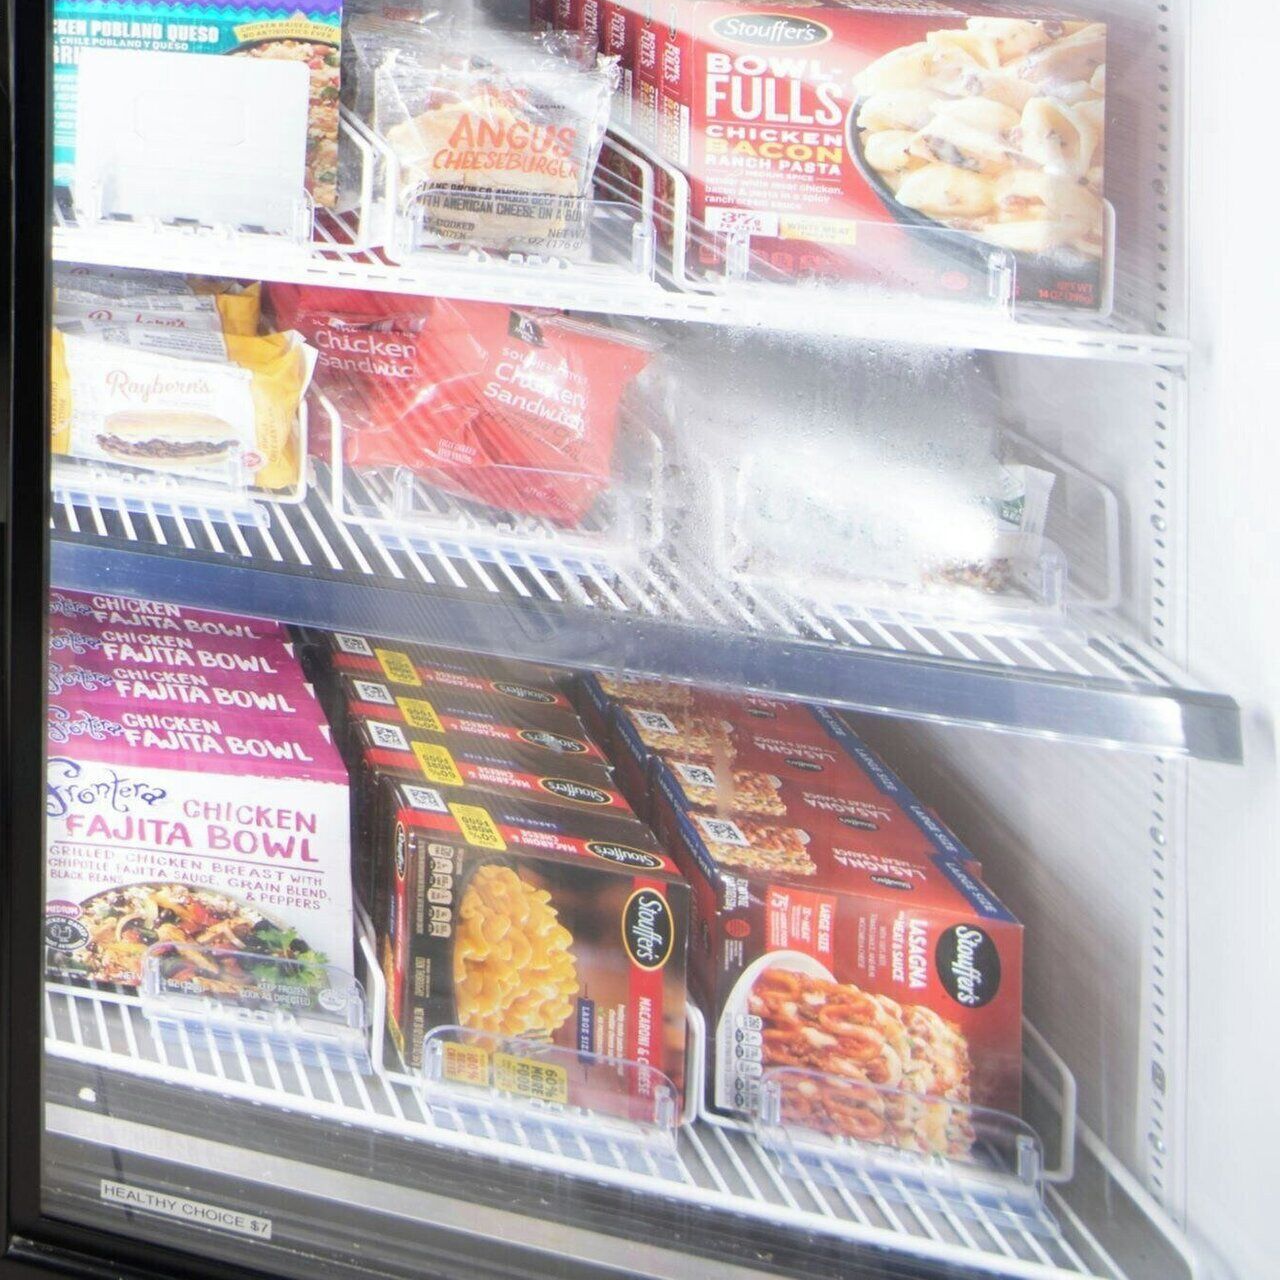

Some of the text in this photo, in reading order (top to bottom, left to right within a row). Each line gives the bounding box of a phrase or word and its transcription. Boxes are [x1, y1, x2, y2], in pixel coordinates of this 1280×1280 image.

[92, 21, 219, 42] POBLANO QUESO
[723, 18, 815, 42] Stouffer's
[60, 38, 90, 46] CHILE
[92, 39, 140, 48] POBLANO
[152, 42, 188, 50] QUESO
[706, 74, 843, 126] FULLS
[449, 114, 576, 157] ANGUS
[706, 125, 843, 146] CHICKEN
[433, 149, 578, 178] CHEESEBURGER
[705, 154, 841, 175] RANCH PASTA
[706, 138, 843, 164] BACON
[443, 199, 552, 219] AMERICAN CHEESE ON
[705, 194, 736, 204] ranch
[314, 330, 416, 359] Chicken
[106, 370, 213, 402] Raybern's
[93, 597, 180, 618] CHICKEN
[93, 610, 261, 640] FAJITA BOWL
[102, 631, 193, 648] CHICKEN
[104, 642, 277, 674] FAJITA BOWL
[113, 669, 208, 686] CHICKEN
[115, 681, 296, 713] FAJITA BOWL
[122, 713, 221, 734] CHICKEN
[124, 730, 313, 762] FAJITA BOWL
[754, 741, 836, 762] LASAGNA
[547, 780, 603, 803] Stouffer's
[876, 769, 898, 792] SIZE
[47, 758, 317, 834] Frontera CHICKEN
[803, 798, 891, 821] LASAGNA
[462, 816, 488, 827] FOOD
[465, 823, 493, 835] MORE
[910, 805, 958, 853] LARGE SIZE
[66, 814, 318, 862] FAJITA BOWL
[469, 832, 497, 844] 60%
[520, 829, 558, 844] CHEESE
[524, 836, 655, 867] Stouffer's MACARONI
[49, 858, 331, 900] CHIPOTLE FAJITA SAUCE, GRAIN BLEND,
[50, 845, 322, 886] GRILLED CHICKEN BREAST WITH
[51, 870, 83, 881] BLACK
[833, 855, 926, 881] LASAGNA
[945, 862, 997, 913] LARGE SIZE
[246, 893, 320, 910] & PEPPERS
[632, 899, 662, 960] Stouffer's
[818, 904, 832, 952] LARGE SIZE
[892, 920, 904, 942] MEAT
[892, 950, 904, 982] SAUCE
[908, 919, 928, 988] LASAGNA
[950, 926, 982, 1004] Stouffer's
[581, 1006, 590, 1033] LARGE
[638, 996, 652, 1045] MACARONI
[638, 1048, 650, 1056] &
[518, 1063, 529, 1091] FOOD
[530, 1066, 542, 1095] MORE
[546, 1069, 558, 1098] 60%
[104, 1184, 268, 1233] HEALTHY CHOICE $7
